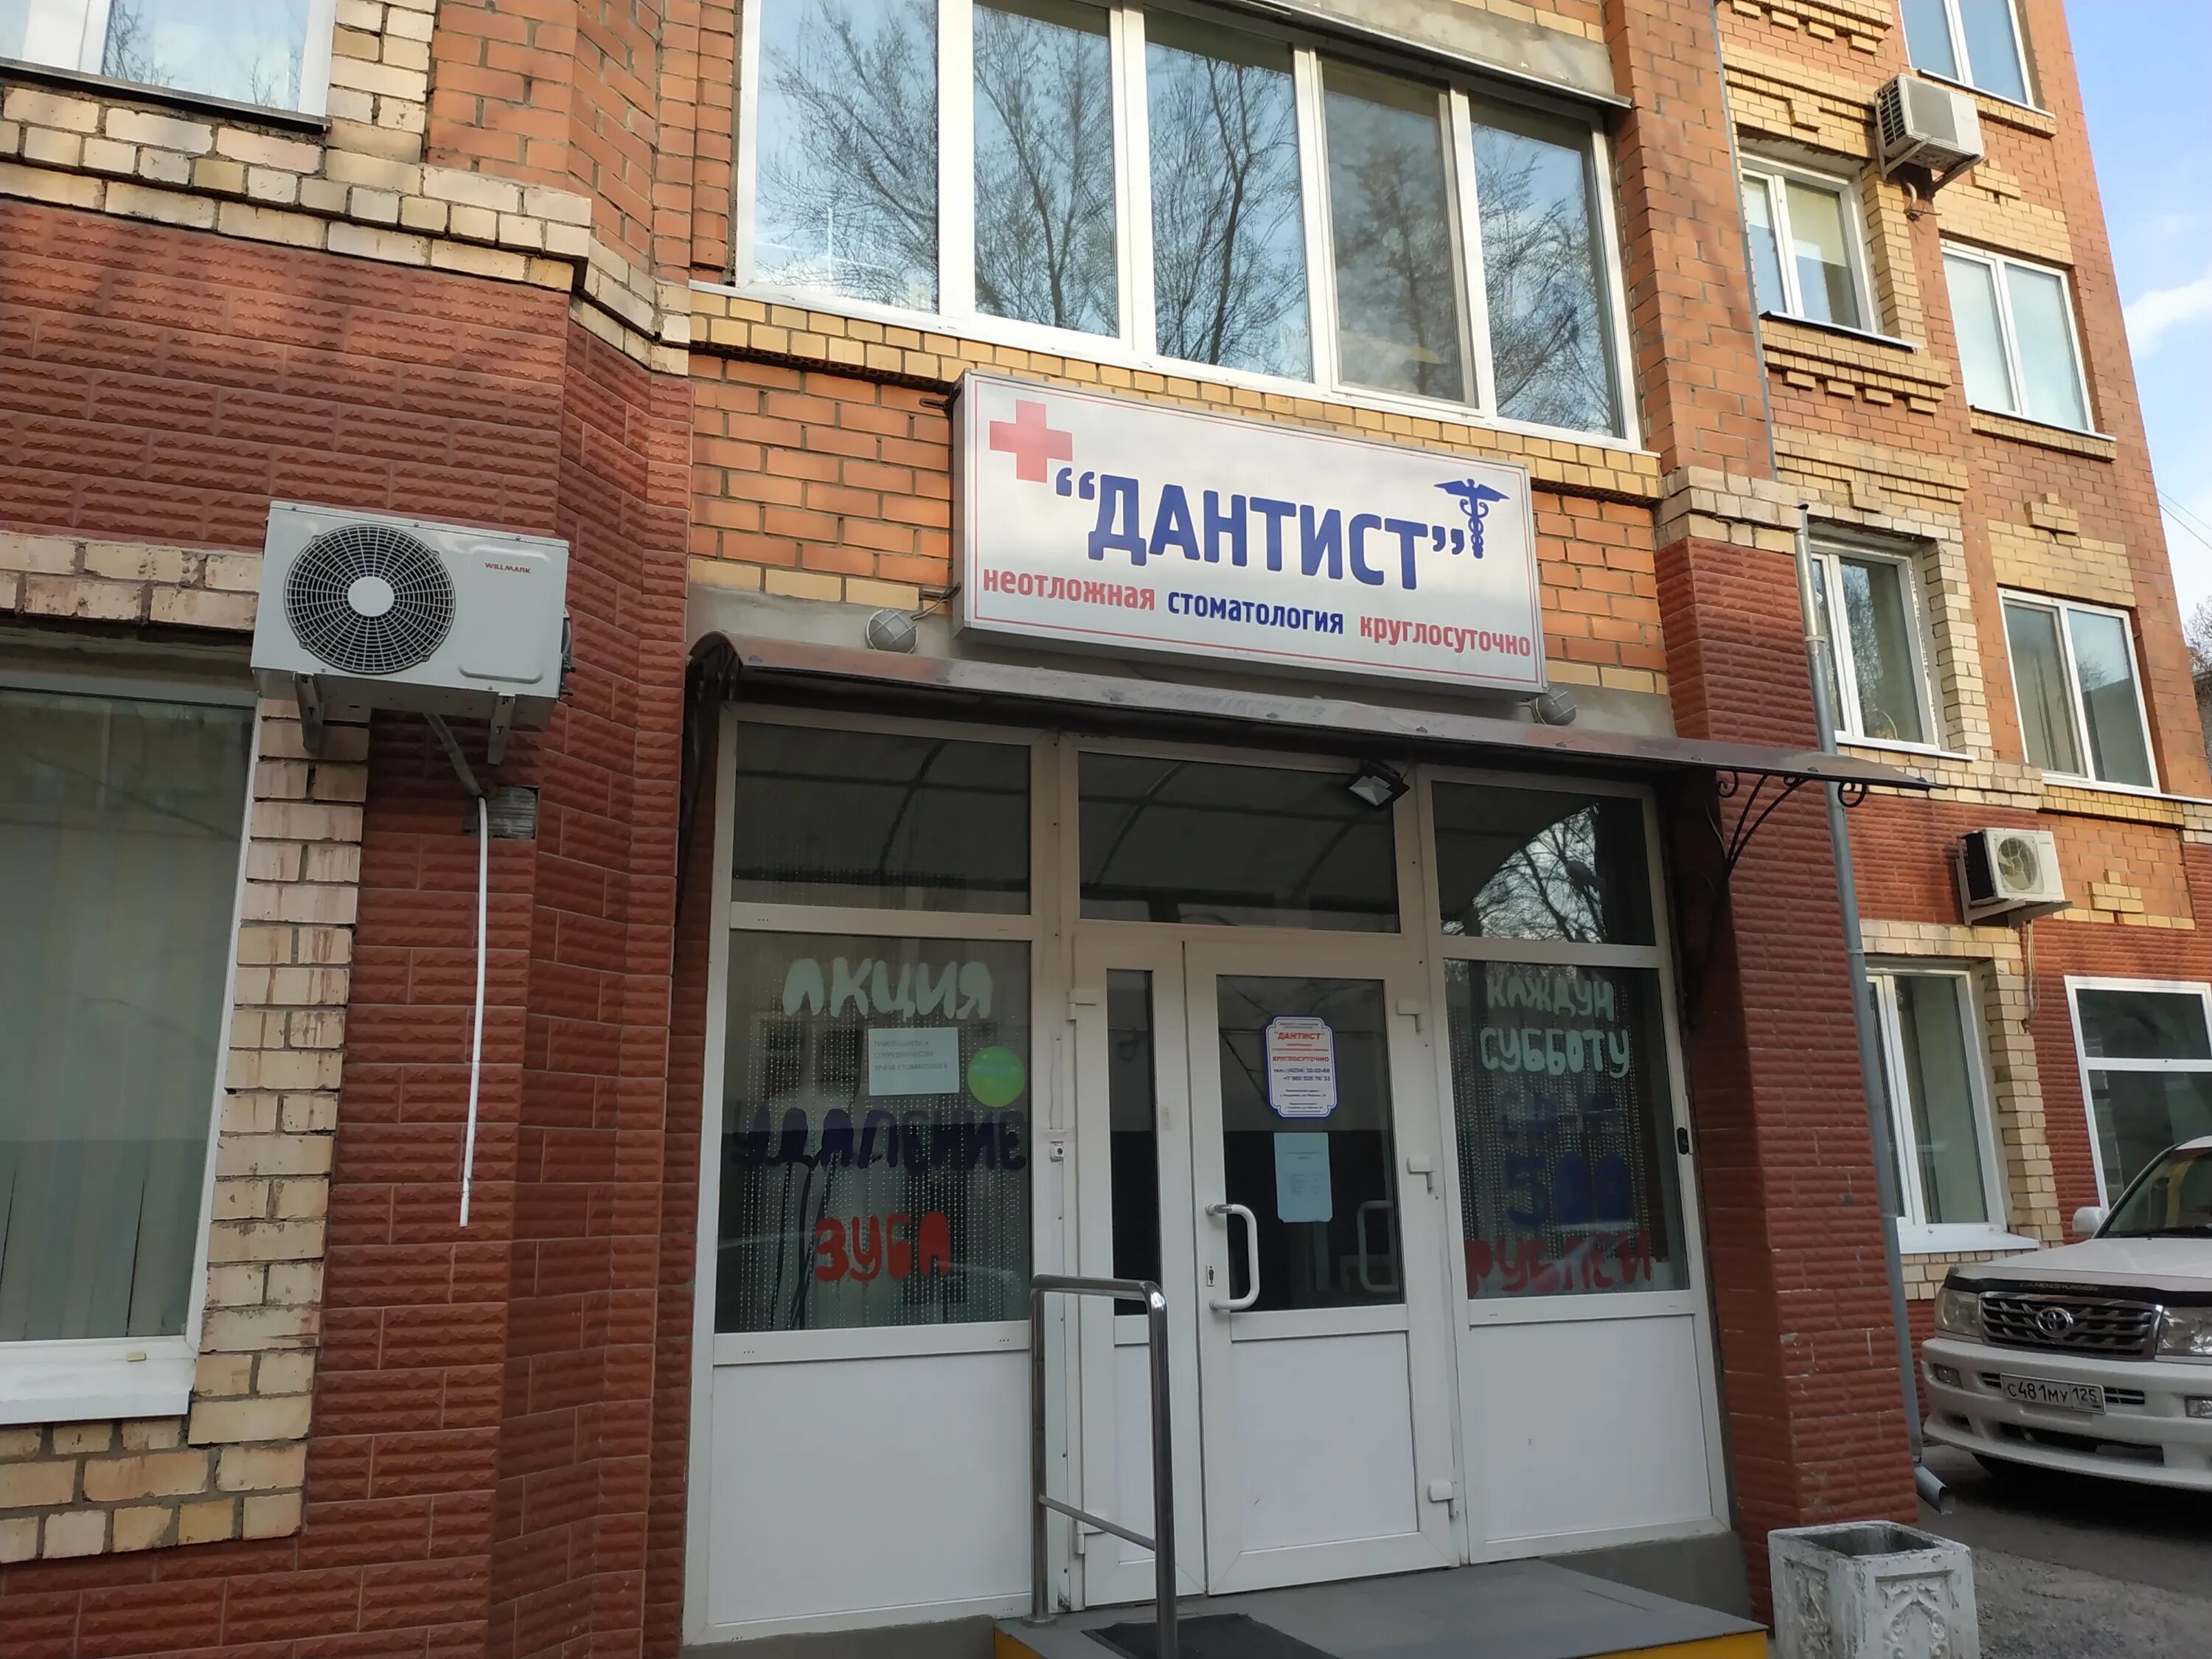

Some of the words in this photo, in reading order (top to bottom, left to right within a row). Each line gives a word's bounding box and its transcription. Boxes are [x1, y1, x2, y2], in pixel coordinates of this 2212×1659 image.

[484, 562, 531, 574] WILLMARK
[982, 568, 1155, 611] неотложная
[1167, 591, 1344, 635] стоматология
[1360, 615, 1531, 656] круглосуточно
[782, 957, 993, 1022] АКЦИЯ
[1479, 1027, 1632, 1077] СУББОТУ
[814, 1211, 951, 1282] ЗУБА
